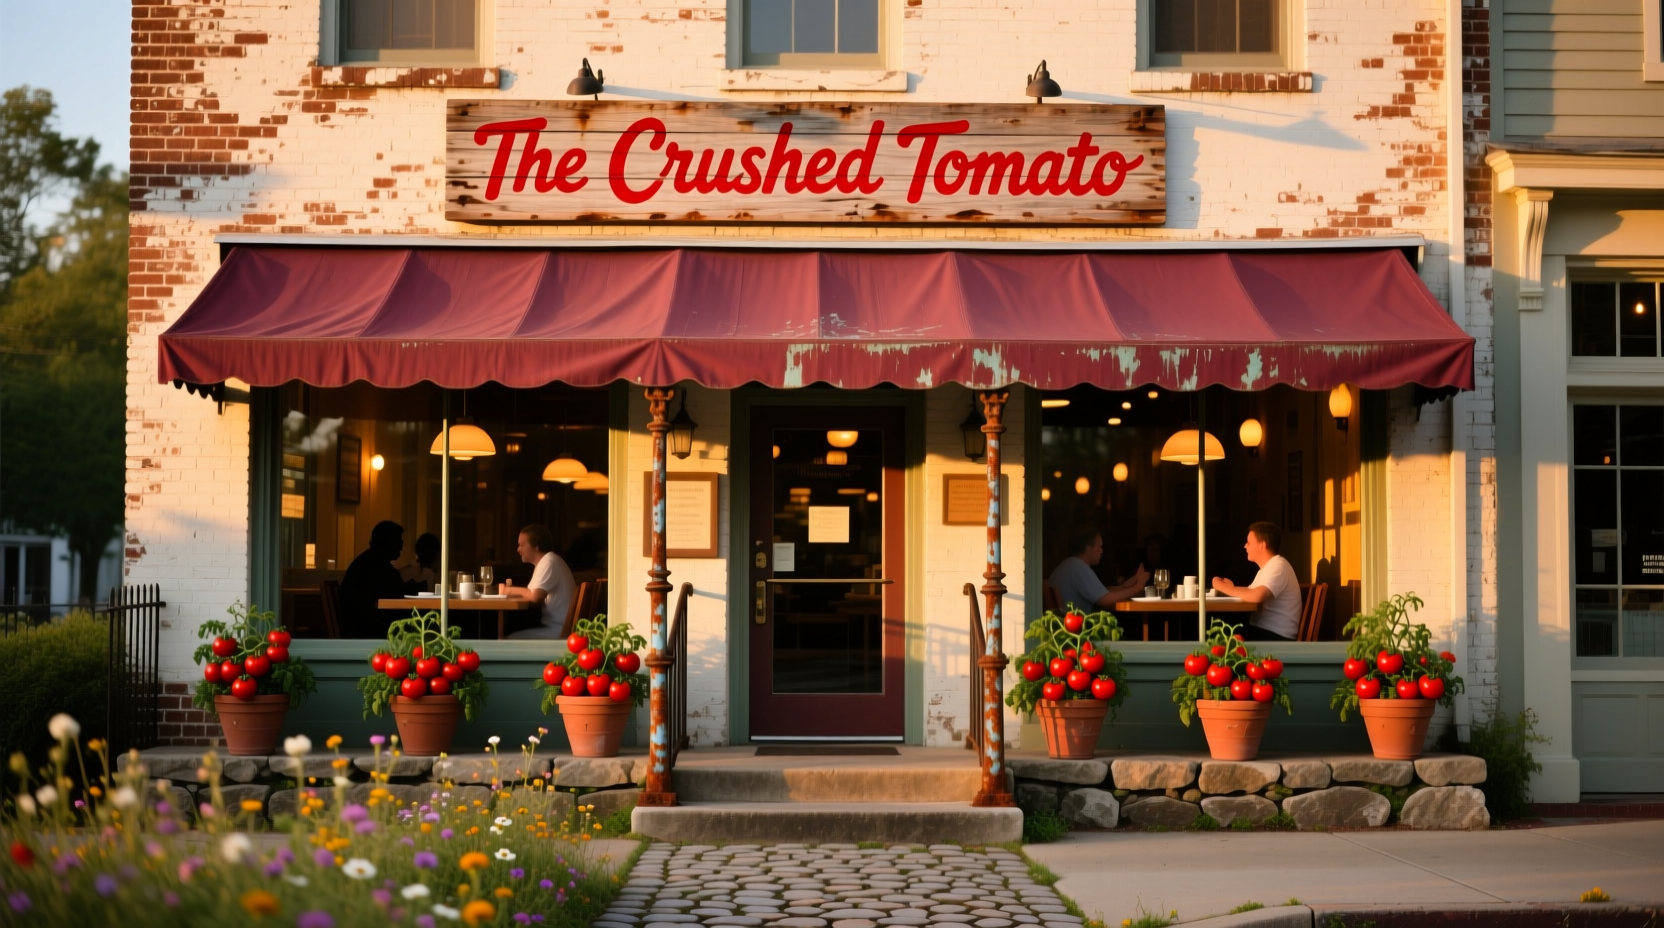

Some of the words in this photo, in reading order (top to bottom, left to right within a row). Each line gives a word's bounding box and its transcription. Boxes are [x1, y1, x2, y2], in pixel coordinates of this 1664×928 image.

[474, 116, 589, 201] The
[608, 117, 885, 204] Crushed
[896, 119, 1146, 204] Tomato
